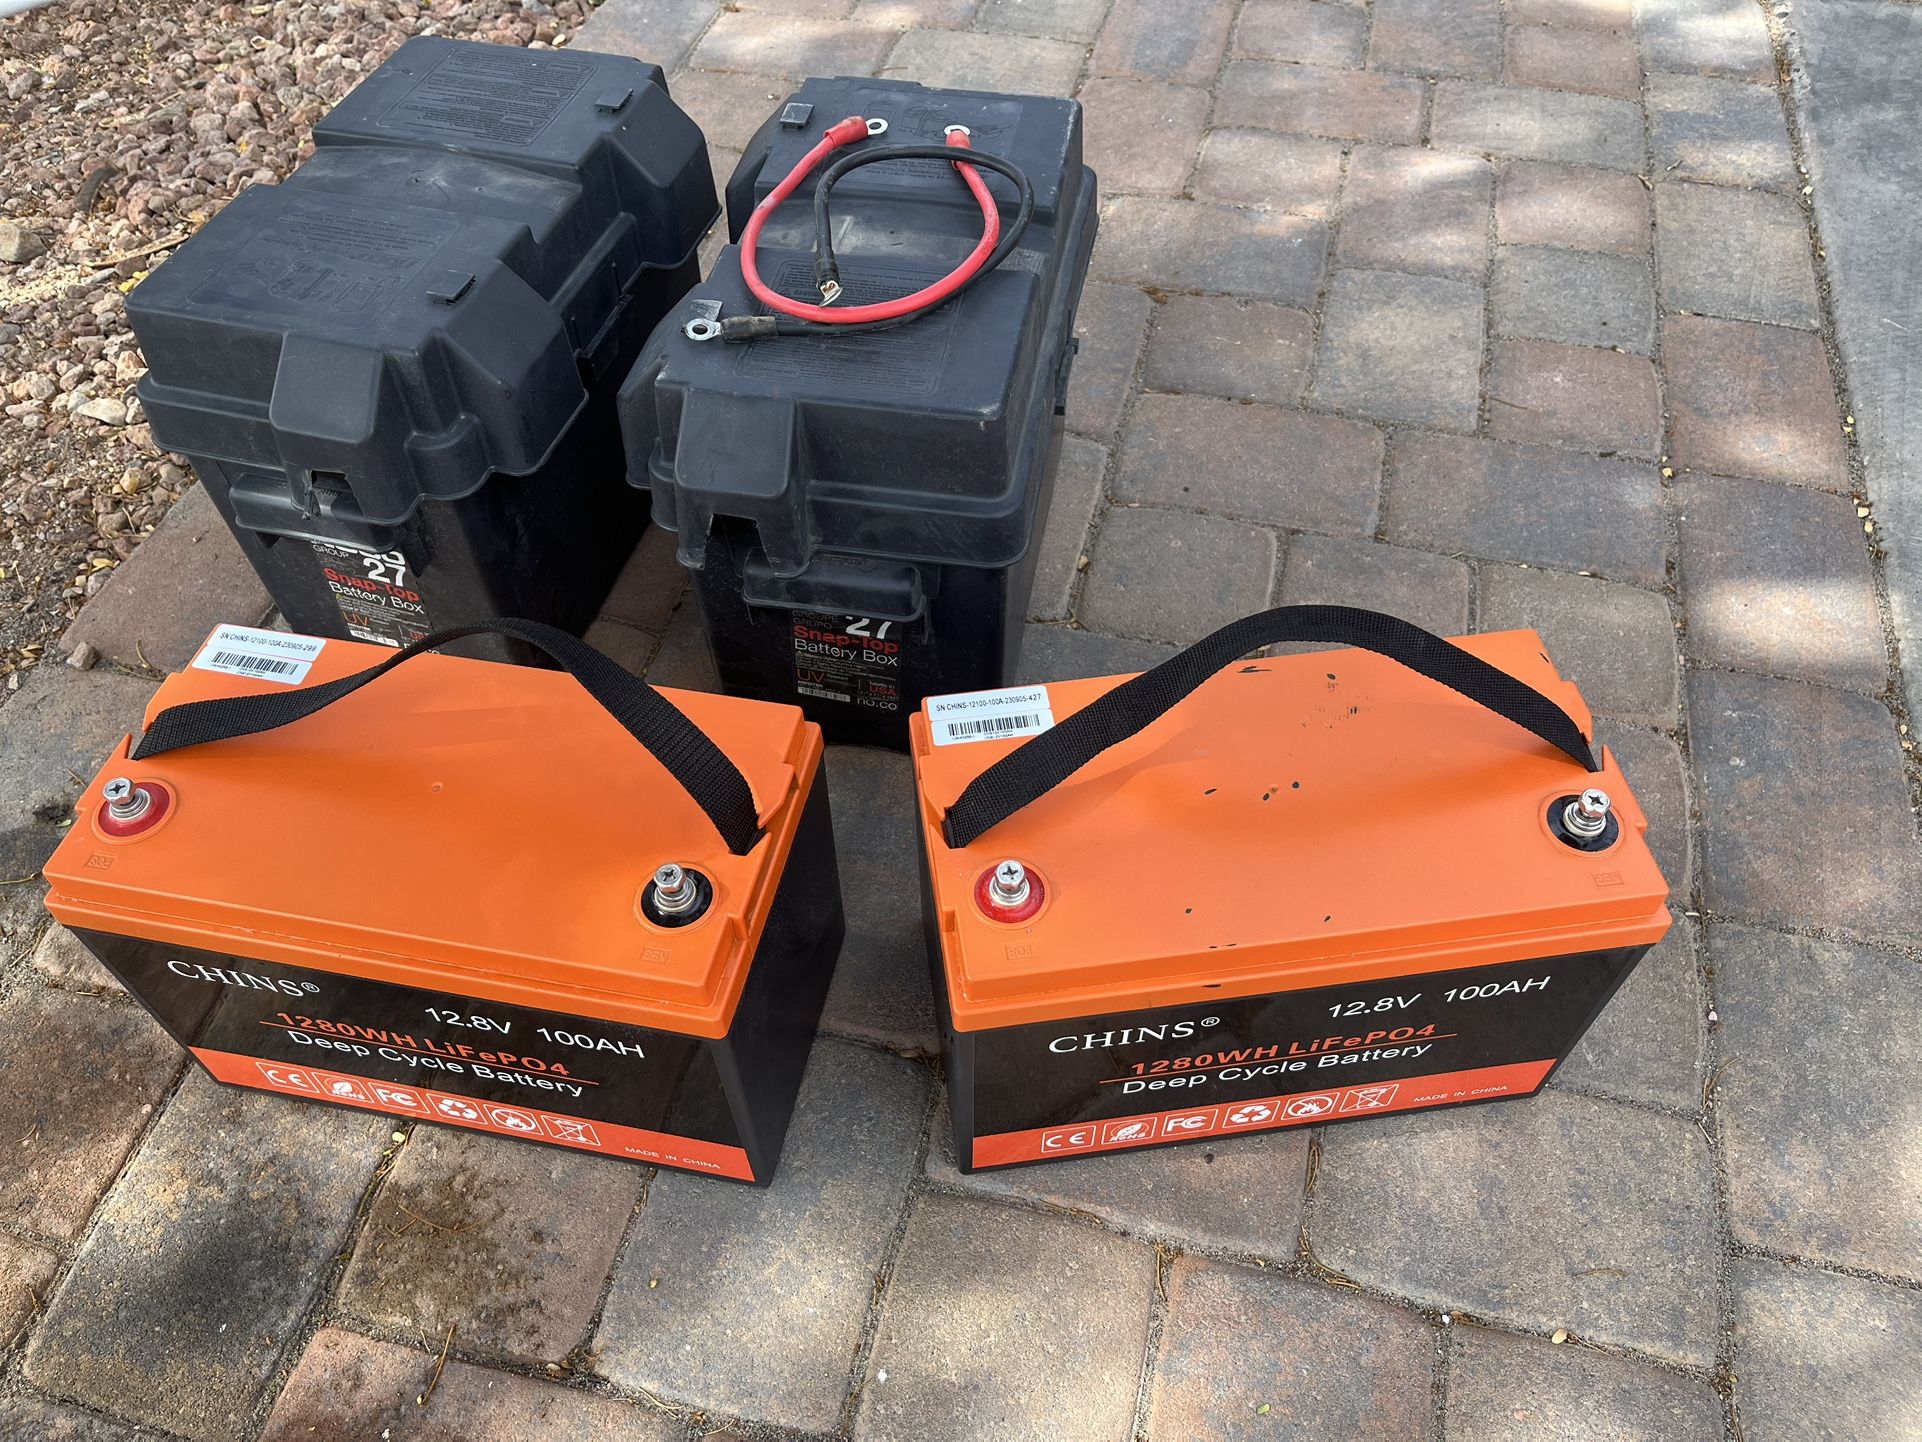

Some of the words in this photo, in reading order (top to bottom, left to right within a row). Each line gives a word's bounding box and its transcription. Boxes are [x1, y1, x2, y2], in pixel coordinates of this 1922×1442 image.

[313, 544, 349, 558] GROUP
[323, 567, 420, 602] Snap-Top
[363, 557, 405, 587] 27
[328, 580, 386, 605] Battery
[390, 596, 424, 615] Box
[342, 610, 369, 626] UV
[794, 624, 898, 655] Snap-Top
[794, 638, 857, 660] Battery
[863, 649, 898, 667] Box
[797, 668, 825, 683] UV
[857, 698, 898, 711] no.co
[869, 686, 897, 696] USA
[936, 704, 946, 712] SN
[1328, 993, 1422, 1018] 12.8V
[1443, 976, 1551, 1003] 100AH
[276, 1012, 419, 1048] 1280WH
[424, 1038, 570, 1076] LiFePO4
[424, 1007, 511, 1035] 12.8V
[536, 1027, 646, 1059] 100AH
[287, 1030, 371, 1057] Deep
[378, 1047, 464, 1074] Cycle
[475, 1063, 583, 1098] Battery
[1131, 1044, 1278, 1075] 1280WH
[1288, 1023, 1437, 1055] LiFePO4
[1122, 1073, 1207, 1094] Deep
[1218, 1060, 1308, 1081] Cycle
[1317, 1043, 1433, 1069] Battery
[1413, 1092, 1449, 1103] MADE
[1471, 1085, 1508, 1094] CHINA
[625, 1146, 660, 1158] MADE
[683, 1157, 721, 1169] CHINA
